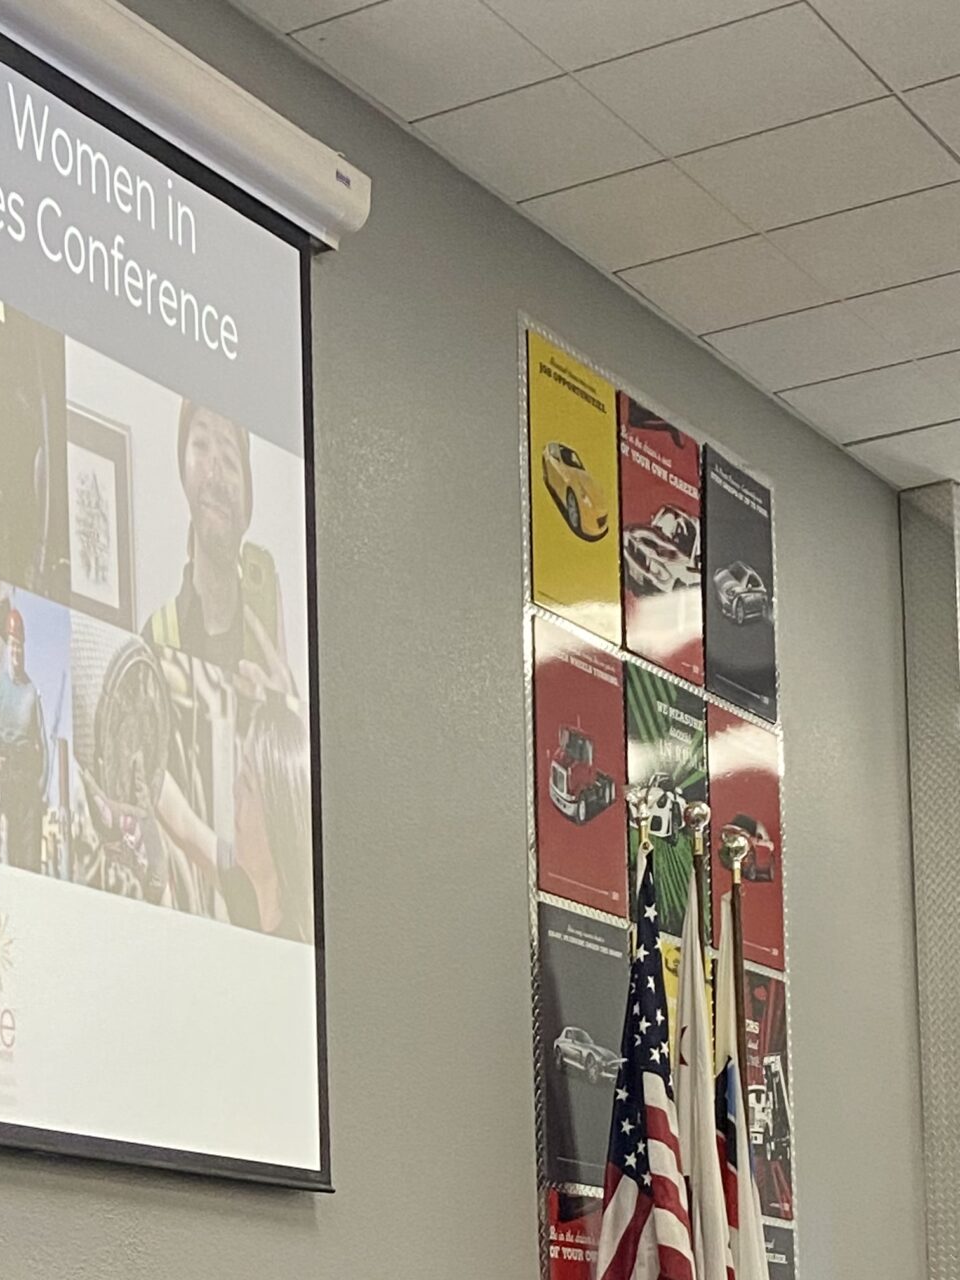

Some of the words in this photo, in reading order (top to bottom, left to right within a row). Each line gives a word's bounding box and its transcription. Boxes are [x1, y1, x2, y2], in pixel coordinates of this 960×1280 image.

[8, 83, 156, 225] Women
[167, 179, 198, 255] in
[36, 198, 238, 361] Conference
[561, 1246, 585, 1261] YOUR
